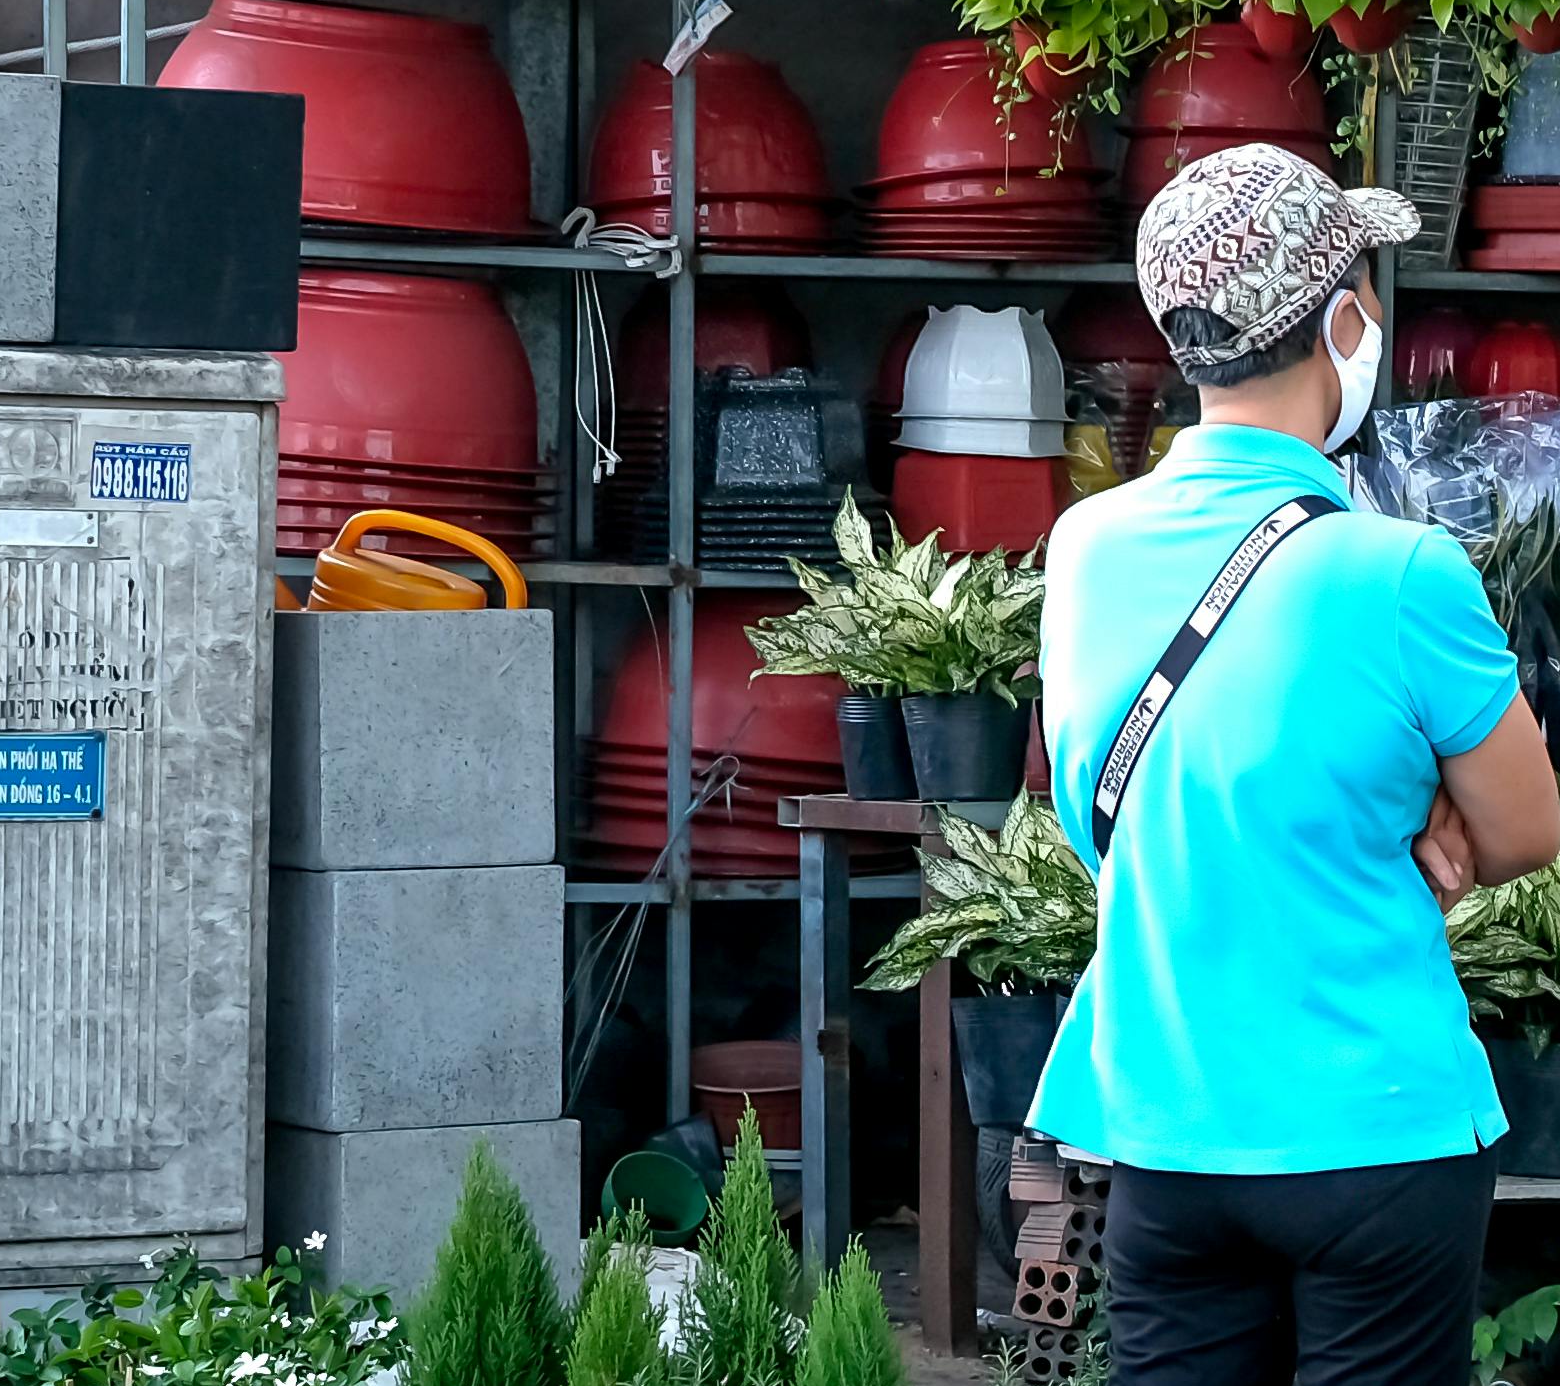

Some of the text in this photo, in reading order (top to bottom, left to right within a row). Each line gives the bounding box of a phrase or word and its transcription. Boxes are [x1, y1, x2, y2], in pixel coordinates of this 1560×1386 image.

[92, 457, 188, 501] 0988.115.118
[1205, 532, 1263, 610] NUTRITION
[1212, 538, 1269, 614] HERBALIFE
[10, 743, 38, 771] PHỐI
[41, 750, 57, 774] HẠ
[1102, 714, 1141, 792] NUTRITION
[1109, 719, 1148, 798] HERBALIFE
[46, 784, 61, 804] 16
[74, 784, 91, 804] 4.1
